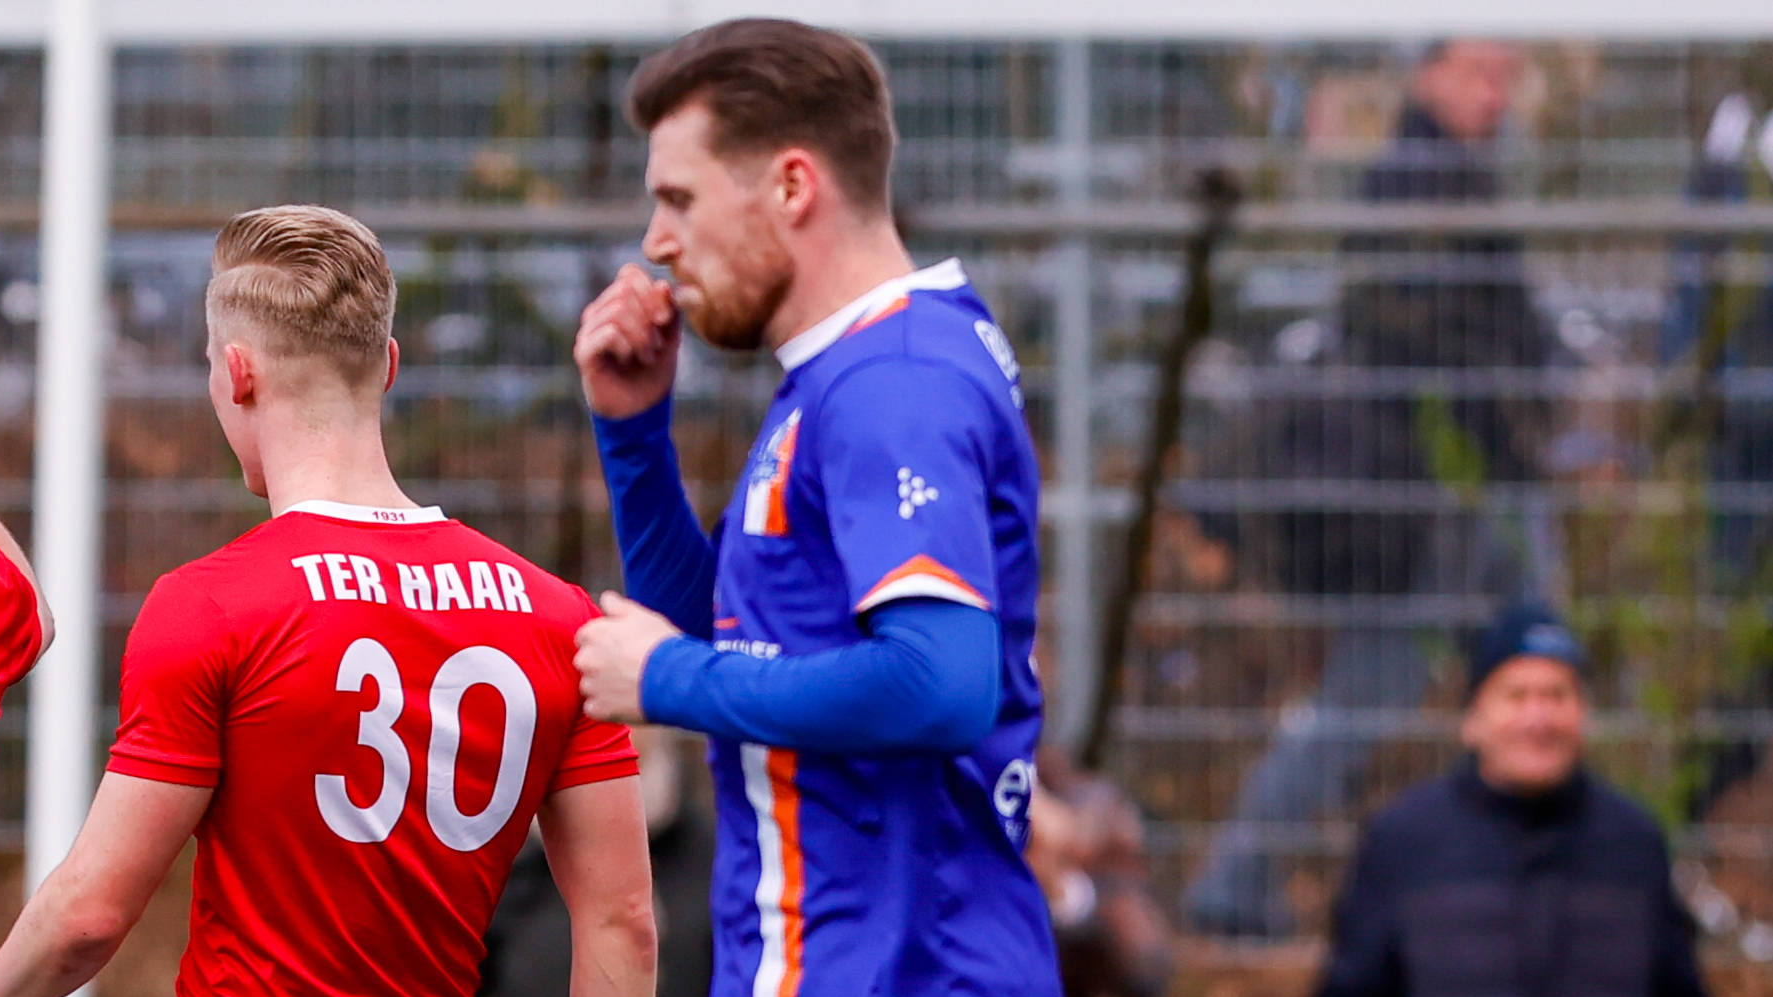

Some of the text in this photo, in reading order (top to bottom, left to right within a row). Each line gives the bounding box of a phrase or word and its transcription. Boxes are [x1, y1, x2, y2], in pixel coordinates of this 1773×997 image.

[372, 511, 406, 522] 1931
[291, 553, 533, 613] TER HAAR
[314, 637, 538, 852] 30
